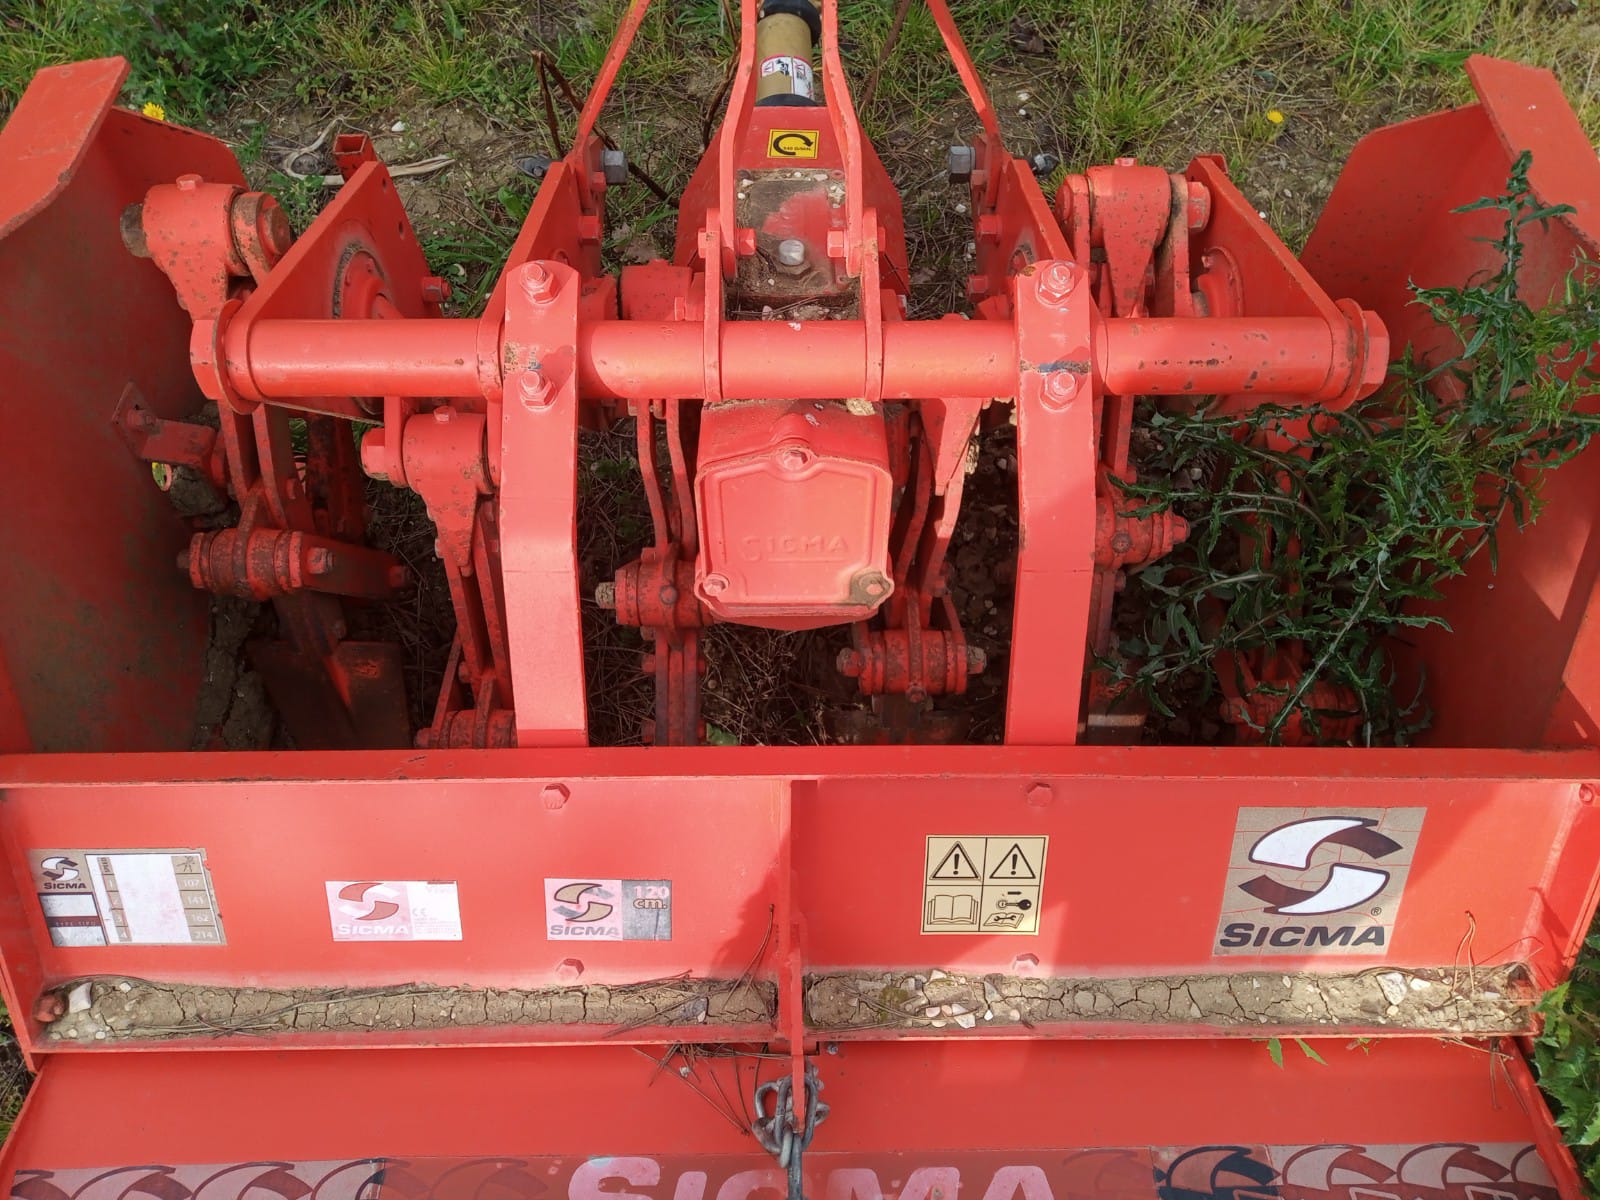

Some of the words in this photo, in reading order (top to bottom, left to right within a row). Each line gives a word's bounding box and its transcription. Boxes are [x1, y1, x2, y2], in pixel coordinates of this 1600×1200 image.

[740, 535, 849, 561] SICMA
[43, 882, 87, 890] SICMA
[183, 879, 200, 887] 107
[633, 885, 670, 899] 120
[633, 898, 668, 910] cm.
[338, 923, 409, 935] SICMA
[550, 924, 620, 936] SICMA
[1220, 923, 1385, 947] SICMA
